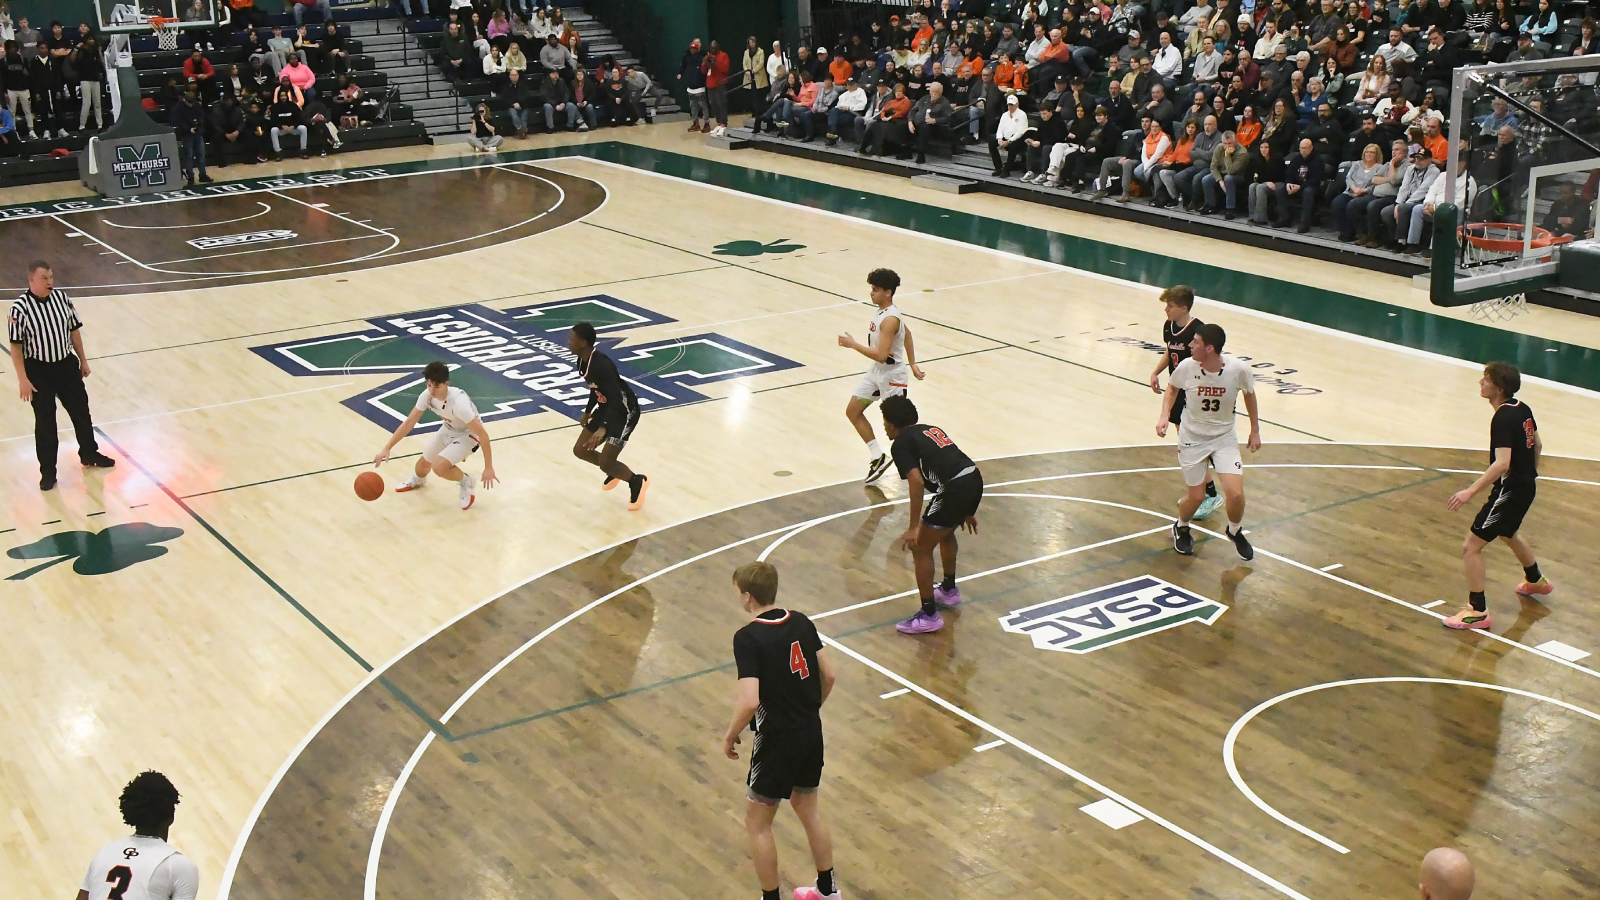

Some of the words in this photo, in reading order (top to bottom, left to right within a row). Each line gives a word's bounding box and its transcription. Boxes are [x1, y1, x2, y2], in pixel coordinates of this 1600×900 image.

[113, 158, 169, 172] MERCYHURST
[386, 313, 655, 413] ERCYHURST
[512, 334, 579, 364] NIVERSITY
[1197, 386, 1227, 397] PREP
[1201, 399, 1221, 412] 33
[923, 427, 954, 449] 12
[1019, 586, 1204, 645] PSAC
[789, 640, 810, 680] 4
[105, 864, 133, 900] 3
